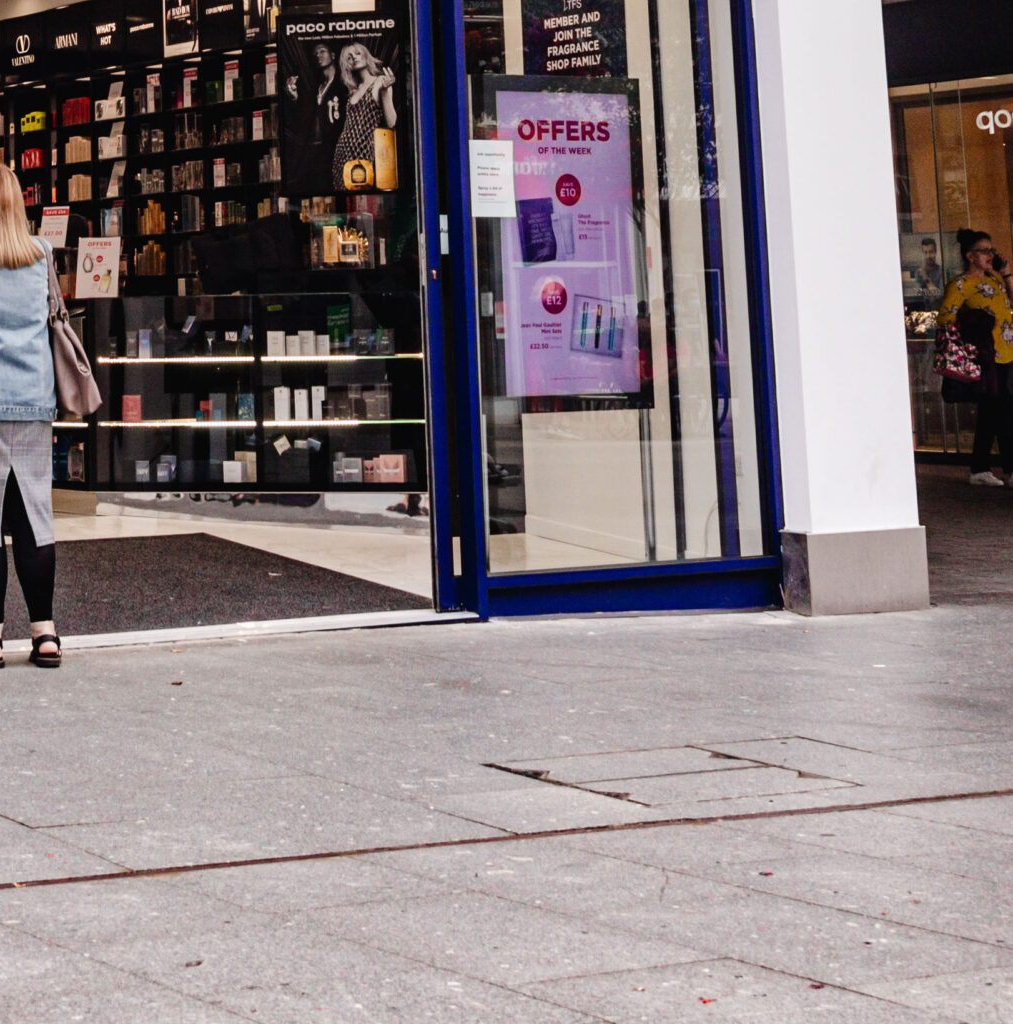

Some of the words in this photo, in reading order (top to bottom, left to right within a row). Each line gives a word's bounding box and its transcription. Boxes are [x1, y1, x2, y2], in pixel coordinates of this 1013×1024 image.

[286, 22, 325, 35] paco
[328, 18, 395, 32] rabanne
[544, 14, 580, 29] MEMBER
[581, 10, 601, 23] AND
[54, 32, 78, 49] ARMANI
[100, 35, 112, 46] HOT
[553, 29, 573, 43] JOIN
[575, 26, 592, 40] THE
[547, 39, 600, 57] FRAGRANCE
[11, 54, 35, 67] VALENTINO
[546, 58, 569, 72] SHOP
[571, 54, 602, 69] FAMILY
[976, 109, 1013, 135] qo
[517, 119, 611, 143] OFFERS
[538, 146, 548, 155] OF
[550, 146, 566, 155] THE
[568, 146, 592, 156] WEEK
[560, 188, 576, 197] £10
[547, 296, 562, 305] £12
